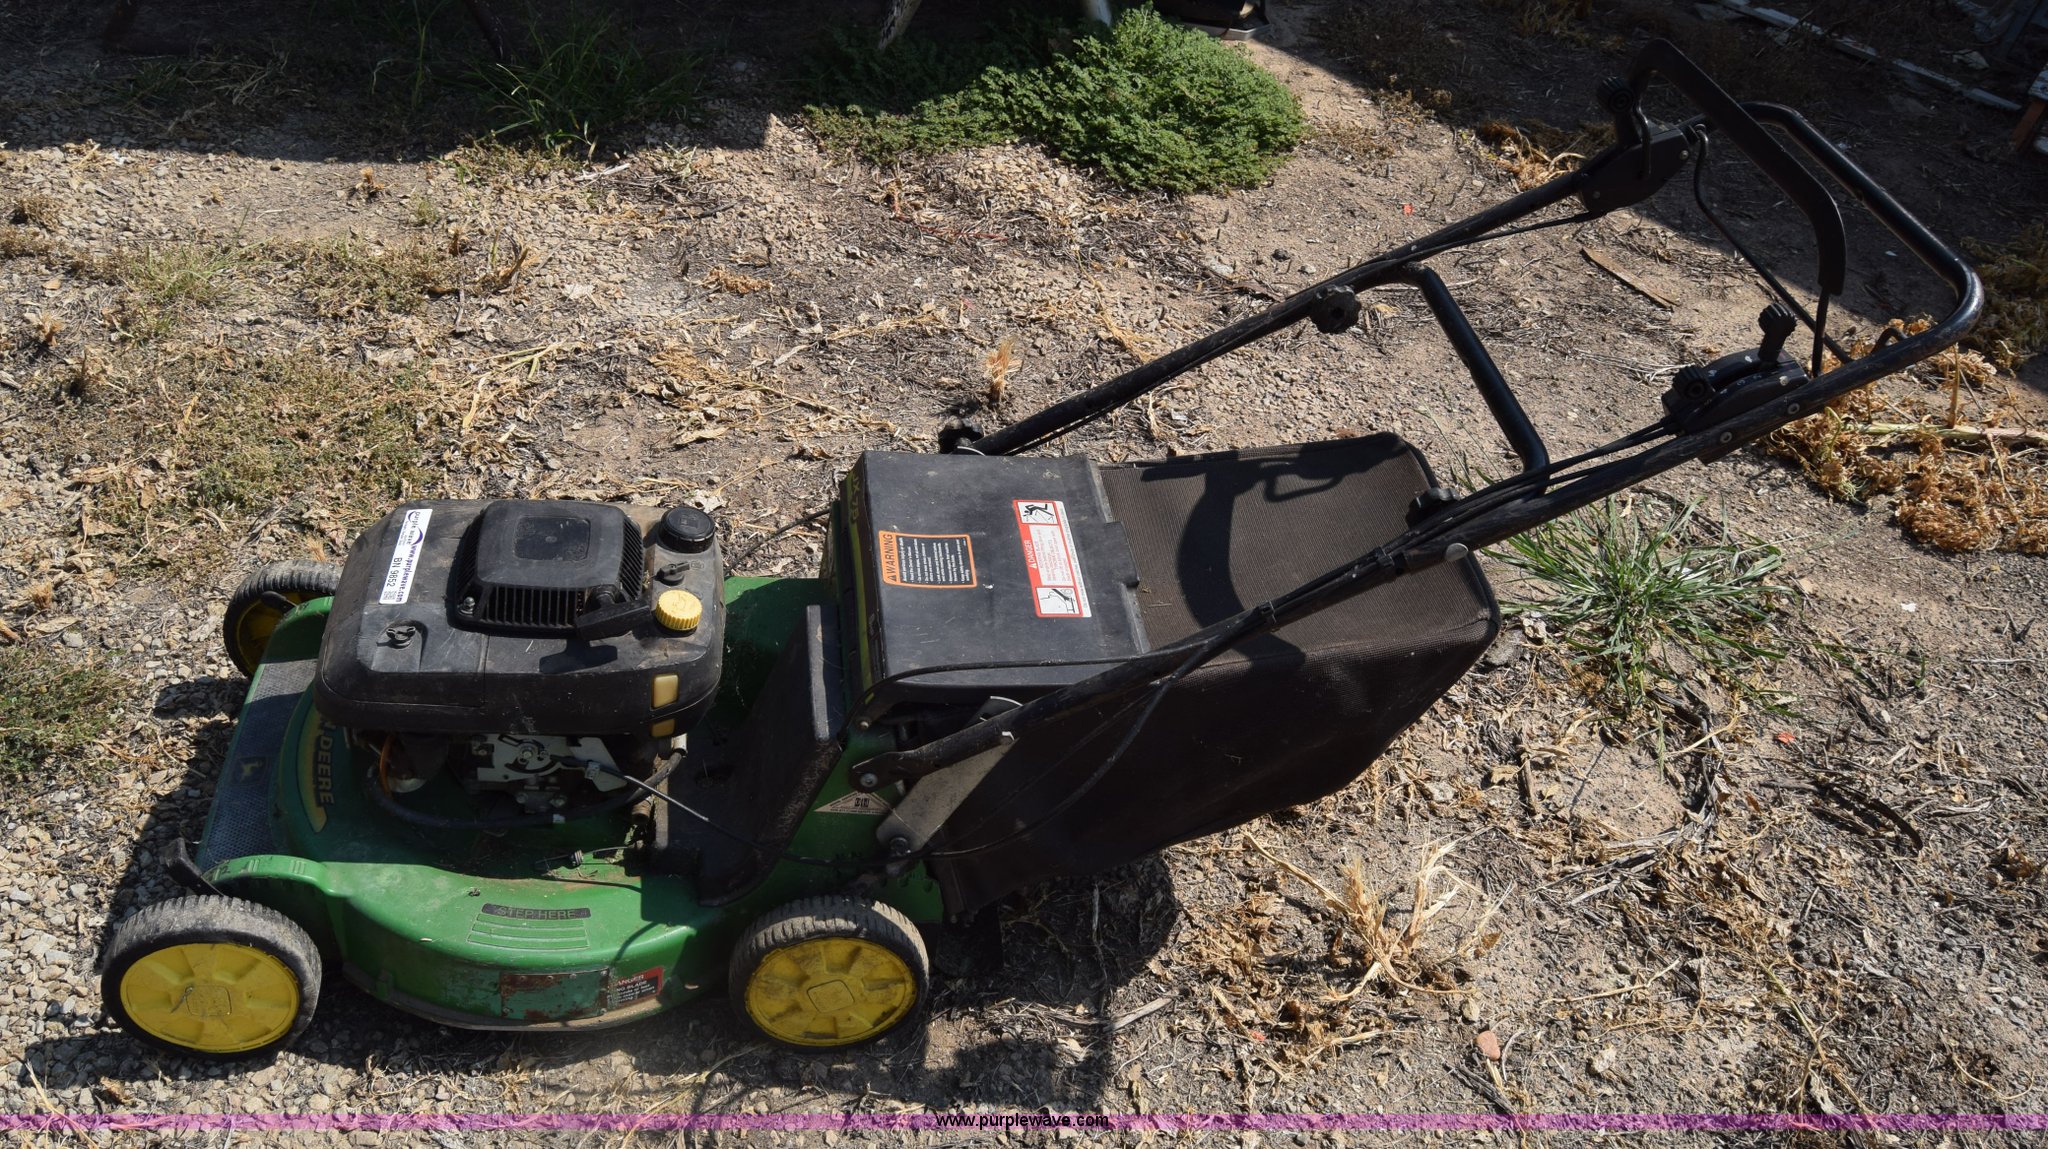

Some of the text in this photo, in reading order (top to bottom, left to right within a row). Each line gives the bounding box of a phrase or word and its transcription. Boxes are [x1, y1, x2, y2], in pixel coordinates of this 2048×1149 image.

[391, 557, 403, 569] BN
[883, 534, 897, 575] WARNING
[1023, 539, 1036, 564] DANGER
[395, 545, 417, 603] www.purplewave.com
[317, 735, 336, 804] DEERE
[496, 905, 576, 920] STEP HERE
